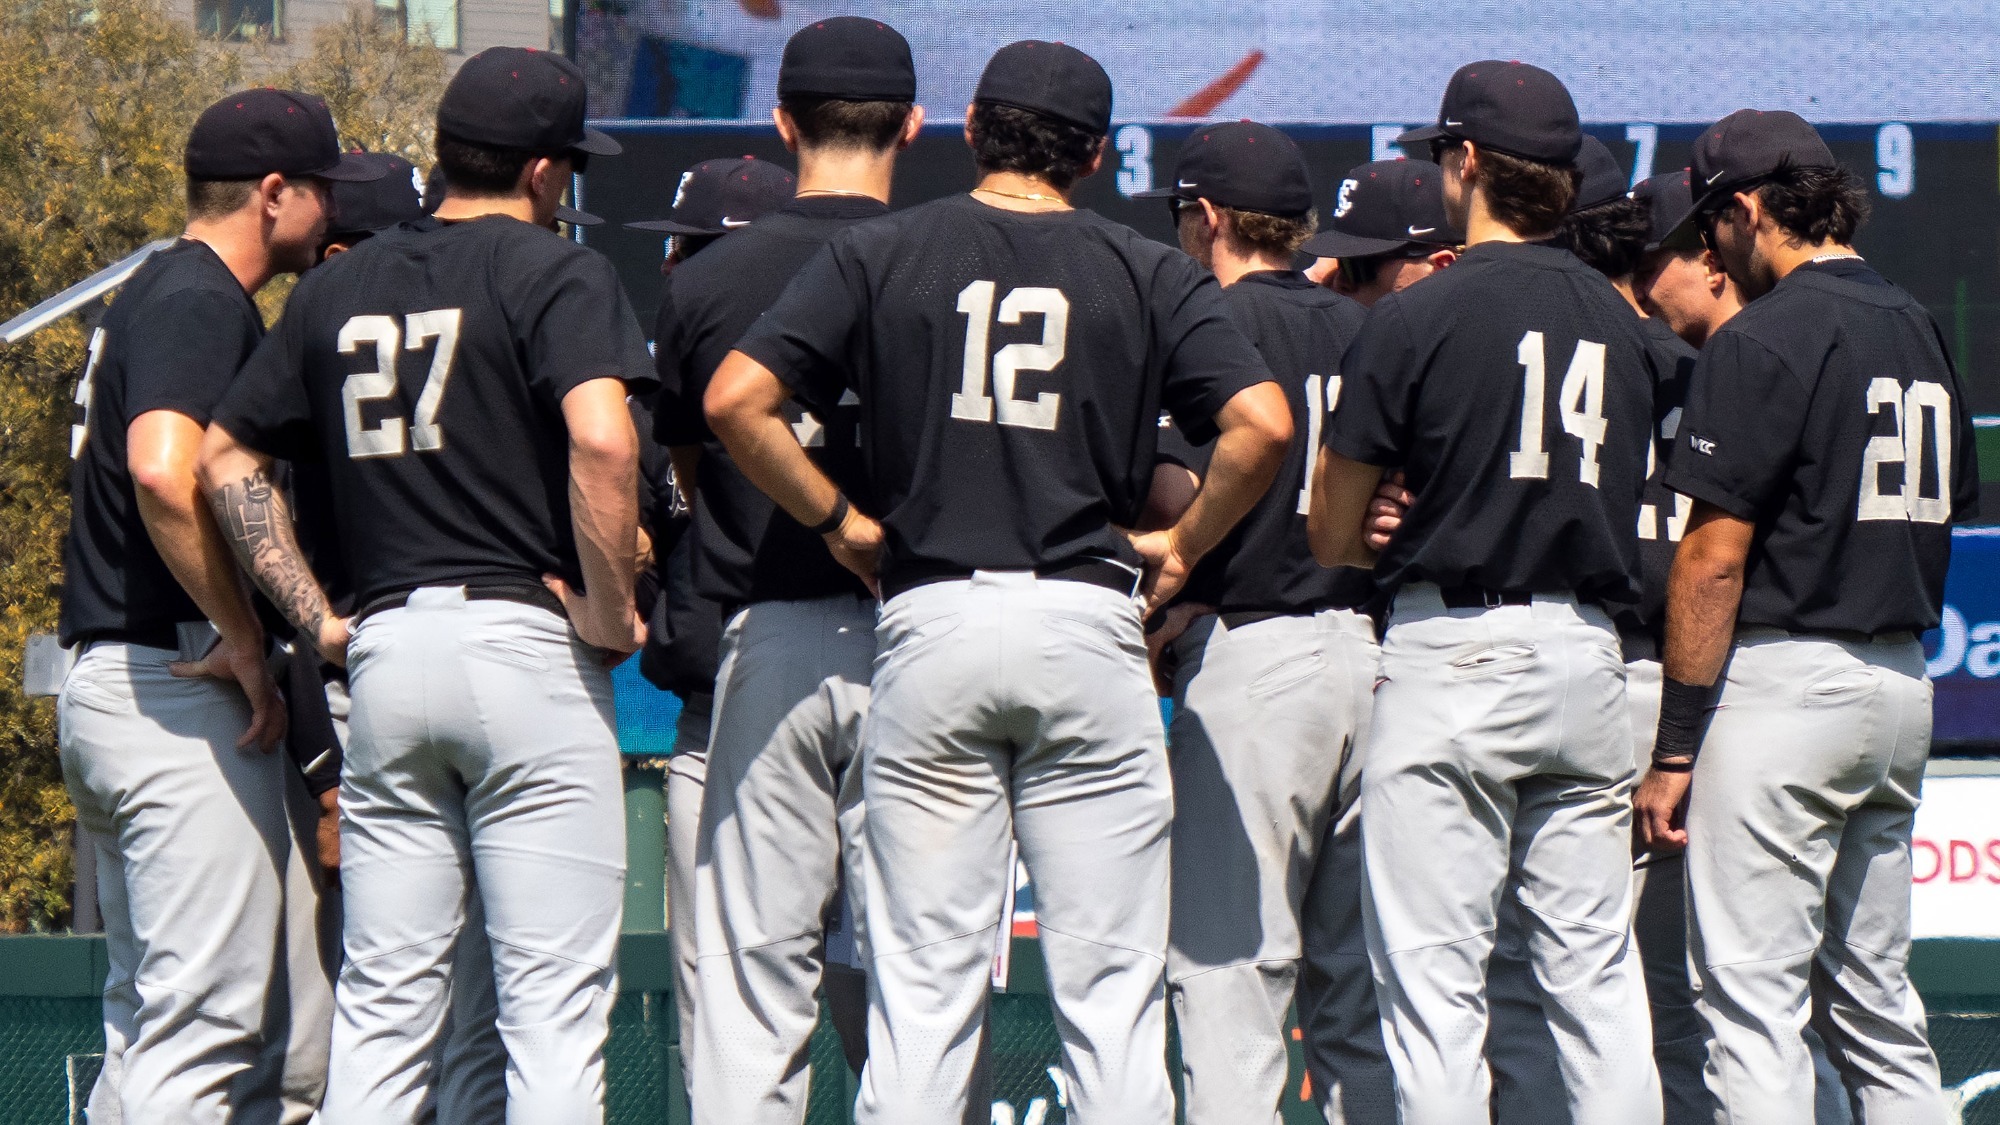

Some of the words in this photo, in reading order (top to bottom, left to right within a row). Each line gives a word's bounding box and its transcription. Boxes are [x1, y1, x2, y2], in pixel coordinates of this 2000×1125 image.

[1116, 124, 1154, 198] 3
[1625, 123, 1658, 193] 7
[1876, 121, 1915, 196] 9
[337, 308, 461, 458] 27
[950, 279, 1069, 431] 12
[1509, 330, 1608, 489] 14
[1857, 377, 1951, 524] 20
